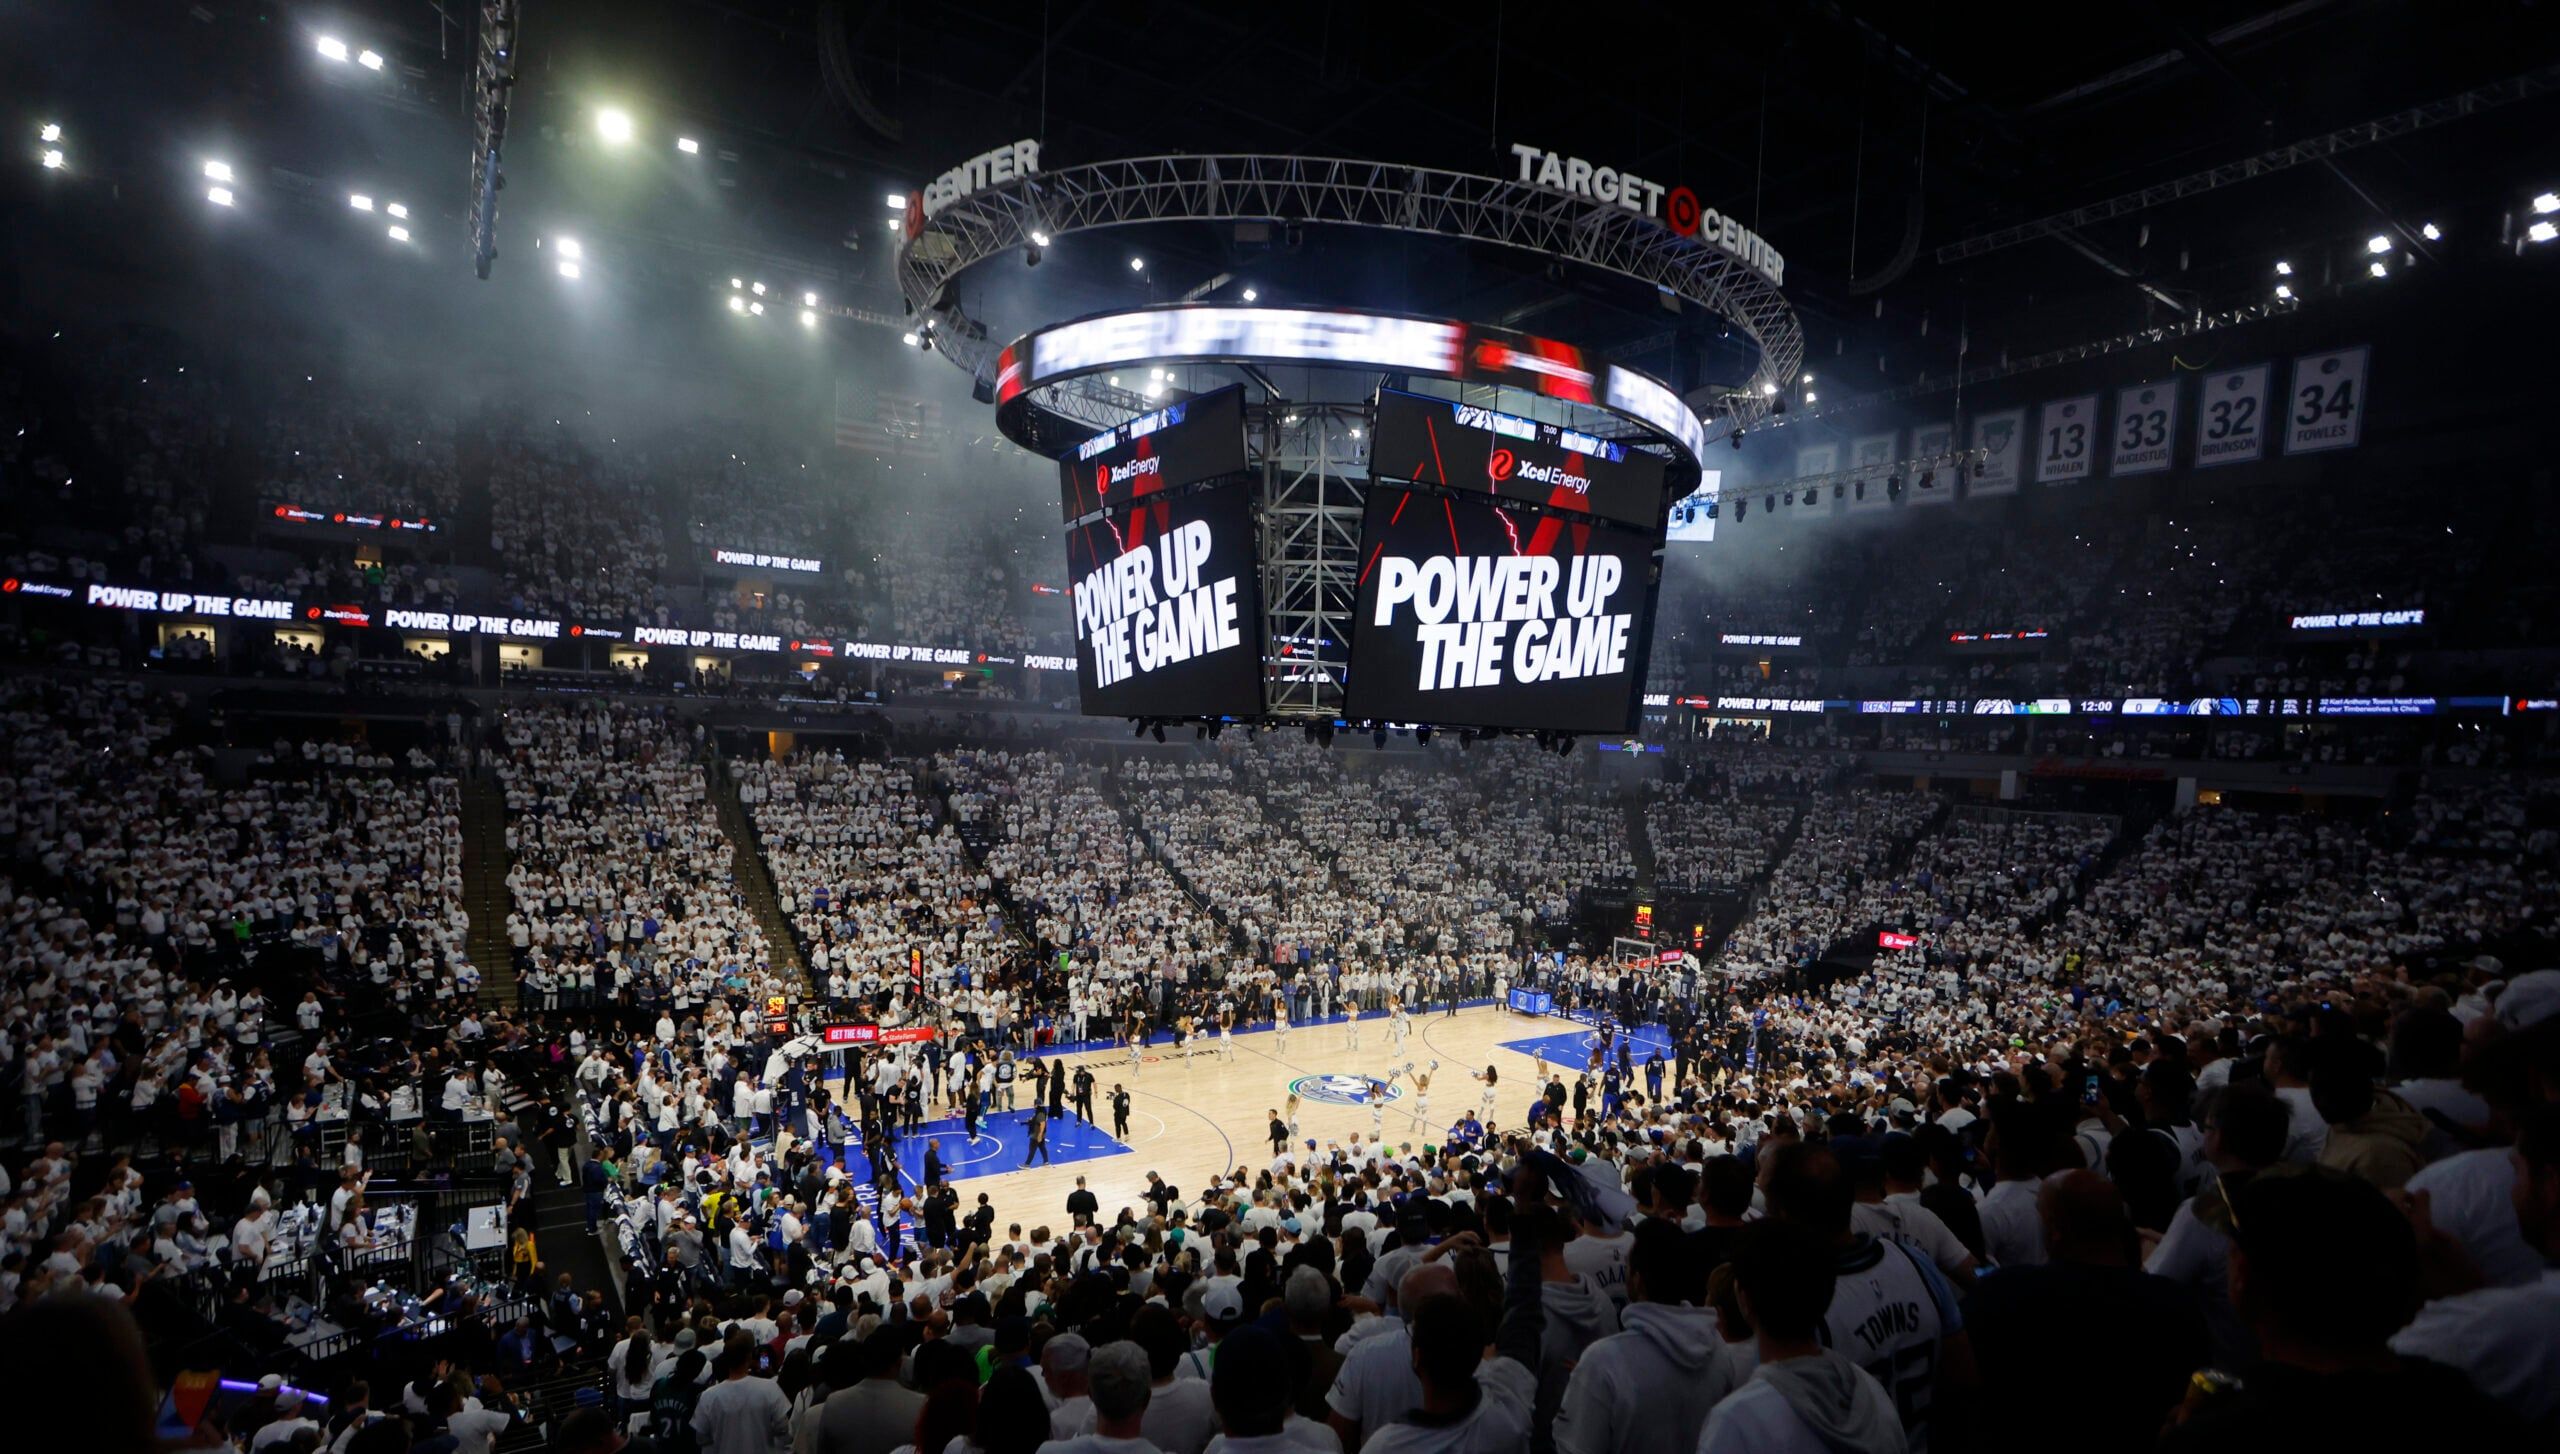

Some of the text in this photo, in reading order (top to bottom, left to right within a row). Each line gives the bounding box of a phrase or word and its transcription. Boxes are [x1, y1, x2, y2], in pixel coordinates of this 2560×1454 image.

[923, 138, 1040, 217] CENTER
[1511, 143, 1785, 287] TARGET CENTER
[2296, 379, 2354, 426] 34
[2121, 409, 2167, 450] 33
[2207, 396, 2256, 440] 32
[2047, 423, 2084, 461] 13
[2297, 424, 2347, 443] FOWLES
[2115, 449, 2167, 467] AUGUSTUS
[2201, 438, 2257, 457] BRUNSON
[2045, 461, 2084, 475] WHALEN
[717, 551, 821, 572] POWER UP THE GAME
[1075, 520, 1212, 641] POWER UP
[1375, 554, 1623, 626] POWER UP
[88, 585, 293, 620] POWER UP THE GAME
[385, 610, 560, 638] POWER UP THE GAME
[2292, 615, 2337, 628] POWER
[2338, 614, 2356, 627] UP
[2357, 612, 2382, 625] THE
[634, 626, 780, 652] POWER UP THE GAME
[1092, 609, 1133, 689] THE
[1135, 576, 1240, 674] GAME
[1722, 634, 1801, 646] POWER UP THE GAME
[845, 642, 970, 664] POWER UP THE GAME
[1024, 654, 1063, 671] POWER
[1417, 615, 1506, 690] THE
[1512, 614, 1631, 682] GAME
[1717, 697, 1821, 712] POWER UP THE GAME
[2080, 701, 2113, 711] 12:00
[2344, 705, 2390, 713] Timberwolves
[1637, 912, 1650, 924] 24
[831, 1029, 843, 1039] GET
[844, 1029, 855, 1039] THE
[1854, 1302, 1919, 1350] TOWNS
[659, 1416, 681, 1440] 21
